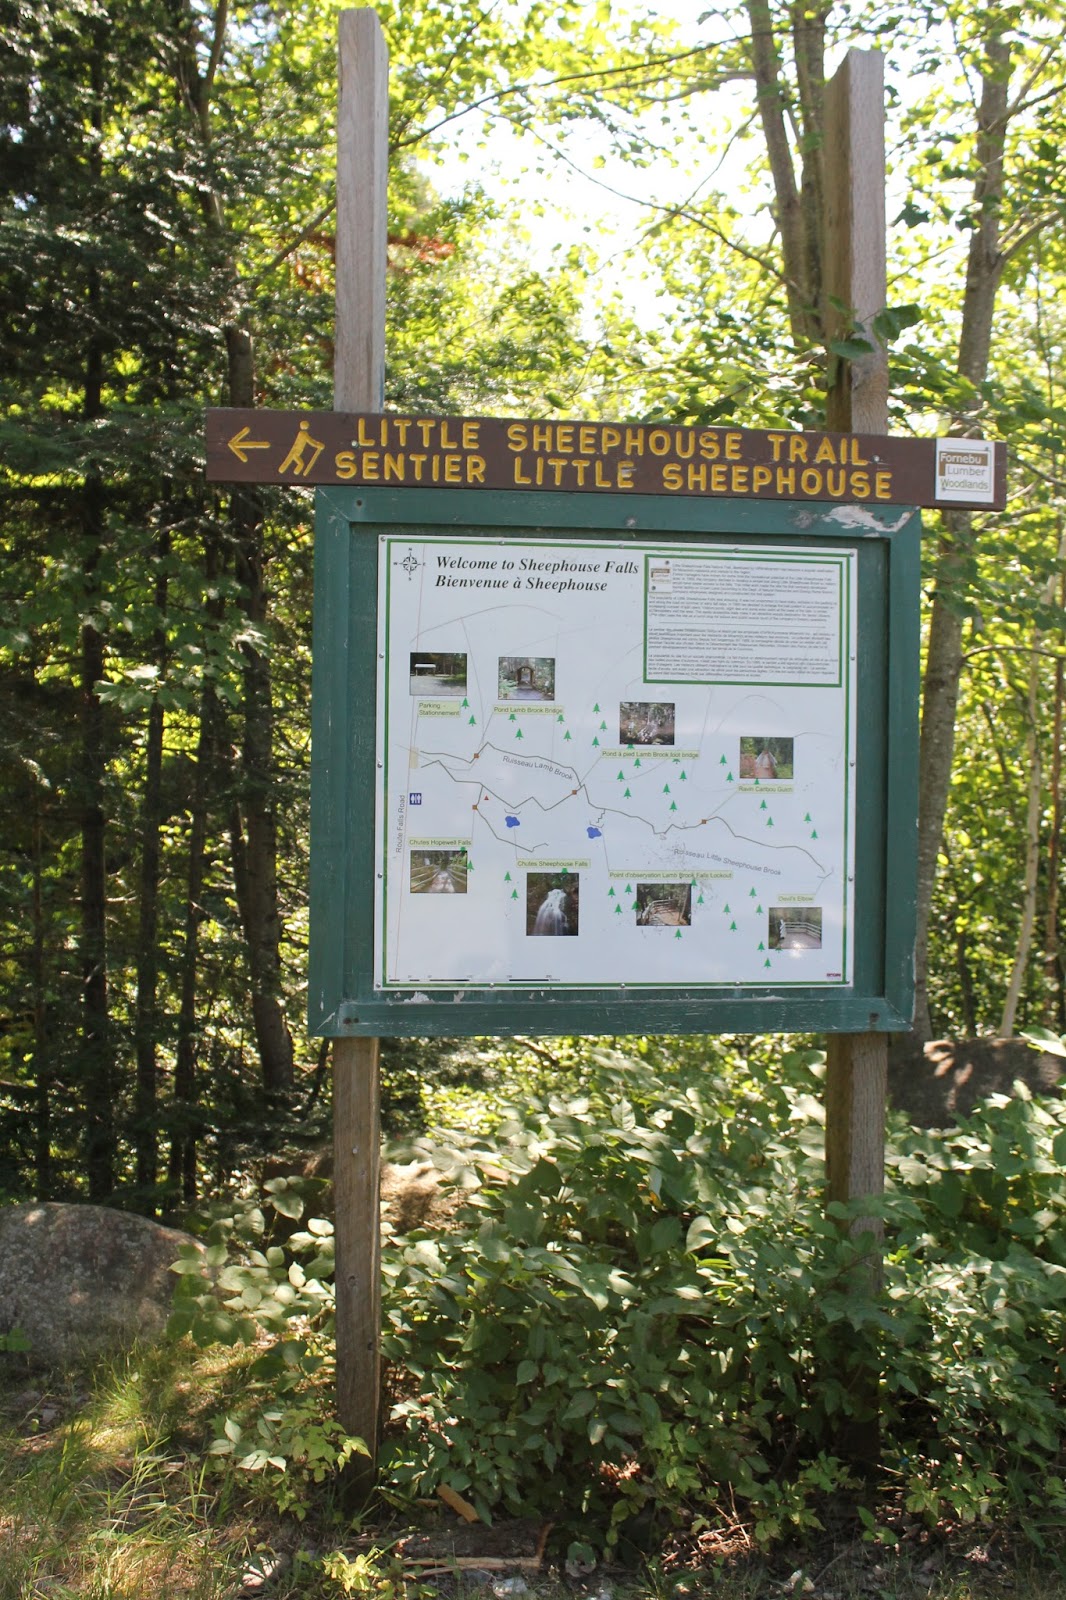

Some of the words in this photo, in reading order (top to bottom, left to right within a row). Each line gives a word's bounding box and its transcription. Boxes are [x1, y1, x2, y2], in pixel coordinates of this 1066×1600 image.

[357, 417, 481, 450] LITTLE
[507, 423, 742, 461] SHEEPHOUSE
[768, 434, 868, 467] TRAIL
[940, 452, 982, 464] Fornebu
[335, 451, 486, 483] SENTIER
[514, 457, 635, 489] LITTLE
[662, 463, 892, 499] SHEEPHOUSE
[947, 465, 986, 476] Lumber
[940, 478, 988, 490] Woodlands
[436, 556, 497, 570] Welcome
[501, 559, 515, 570] to
[519, 558, 601, 577] Sheephouse
[604, 560, 639, 574] Falls
[435, 575, 508, 589] Bienvenue
[512, 576, 522, 589] à
[525, 576, 608, 593] Sheephouse
[544, 707, 564, 715] Bridge
[502, 755, 533, 768] Ruisseau
[534, 761, 554, 774] Lamb
[551, 768, 573, 781] Brook
[397, 794, 405, 813] Road
[396, 814, 404, 831] Falls
[706, 852, 722, 862] Little
[723, 856, 762, 872] Sheephouse
[763, 866, 782, 876] Brook
